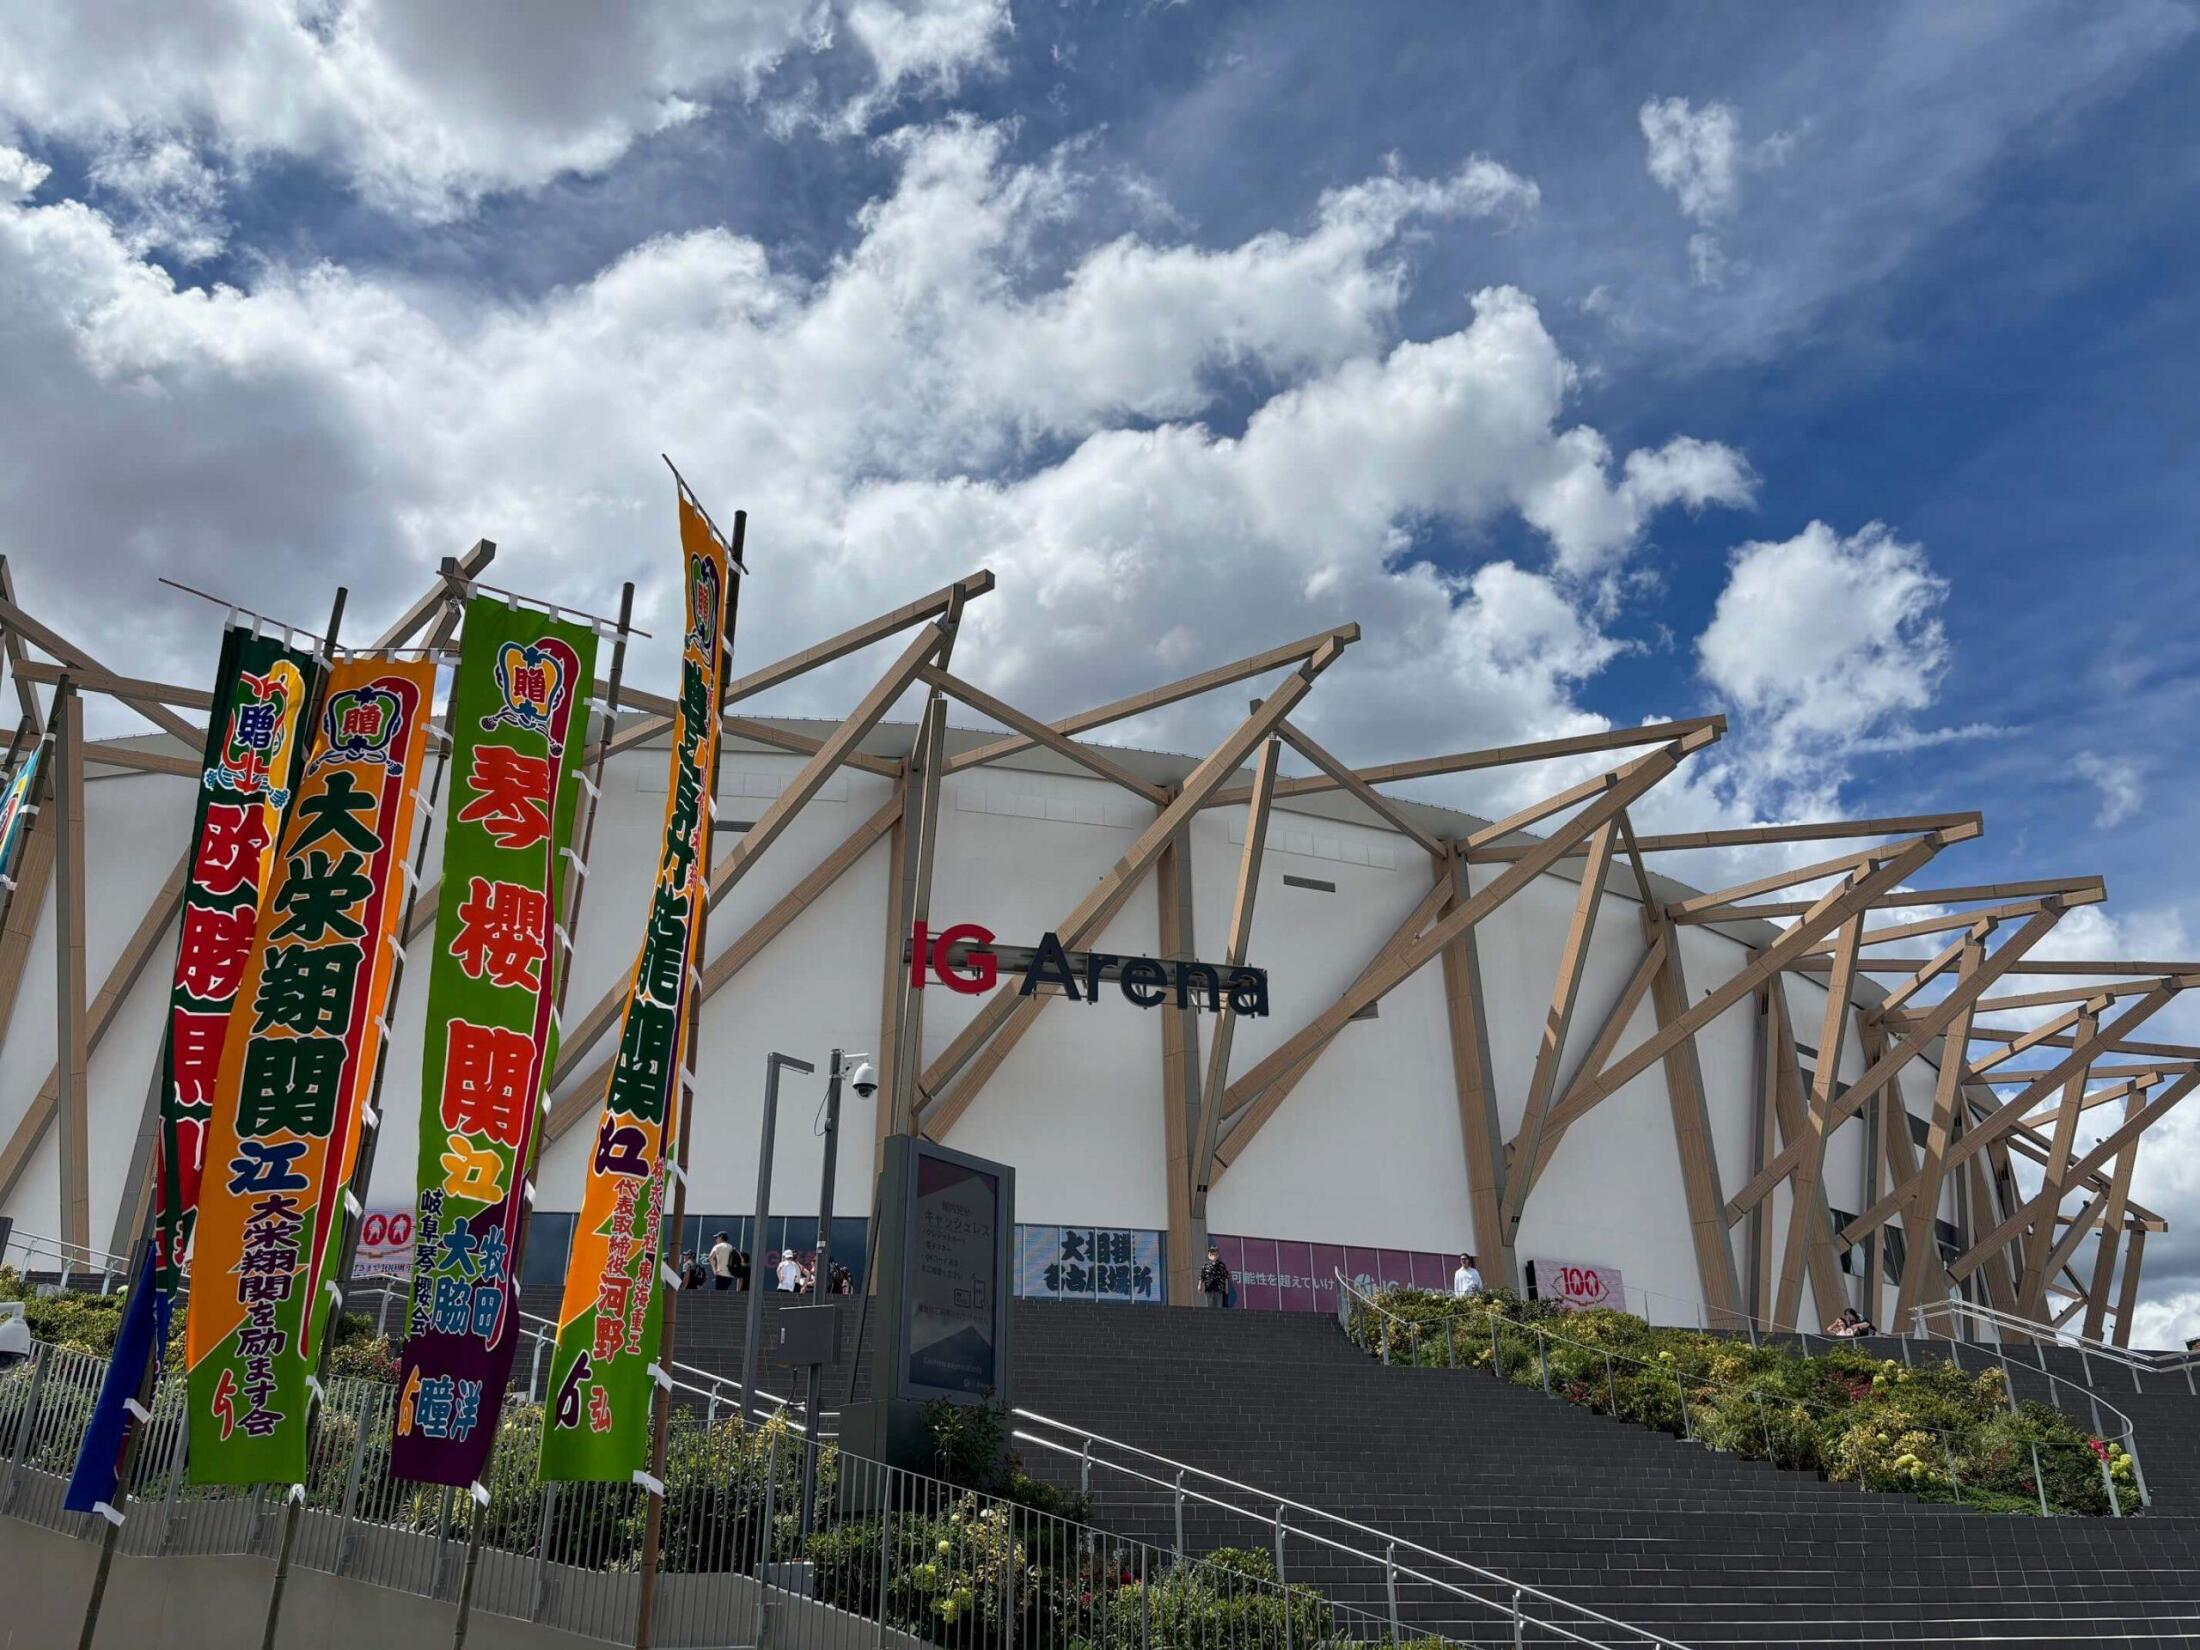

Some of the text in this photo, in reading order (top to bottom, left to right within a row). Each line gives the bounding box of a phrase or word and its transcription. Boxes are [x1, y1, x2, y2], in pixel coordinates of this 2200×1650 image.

[513, 665, 547, 705] 贈
[235, 702, 277, 749] 贈
[342, 703, 383, 737] 贈
[911, 920, 1270, 1018] IG Arena
[1060, 1230, 1137, 1266] 大相撲
[1043, 1263, 1153, 1298] 名古屋場所
[1560, 1266, 1600, 1297] 100
